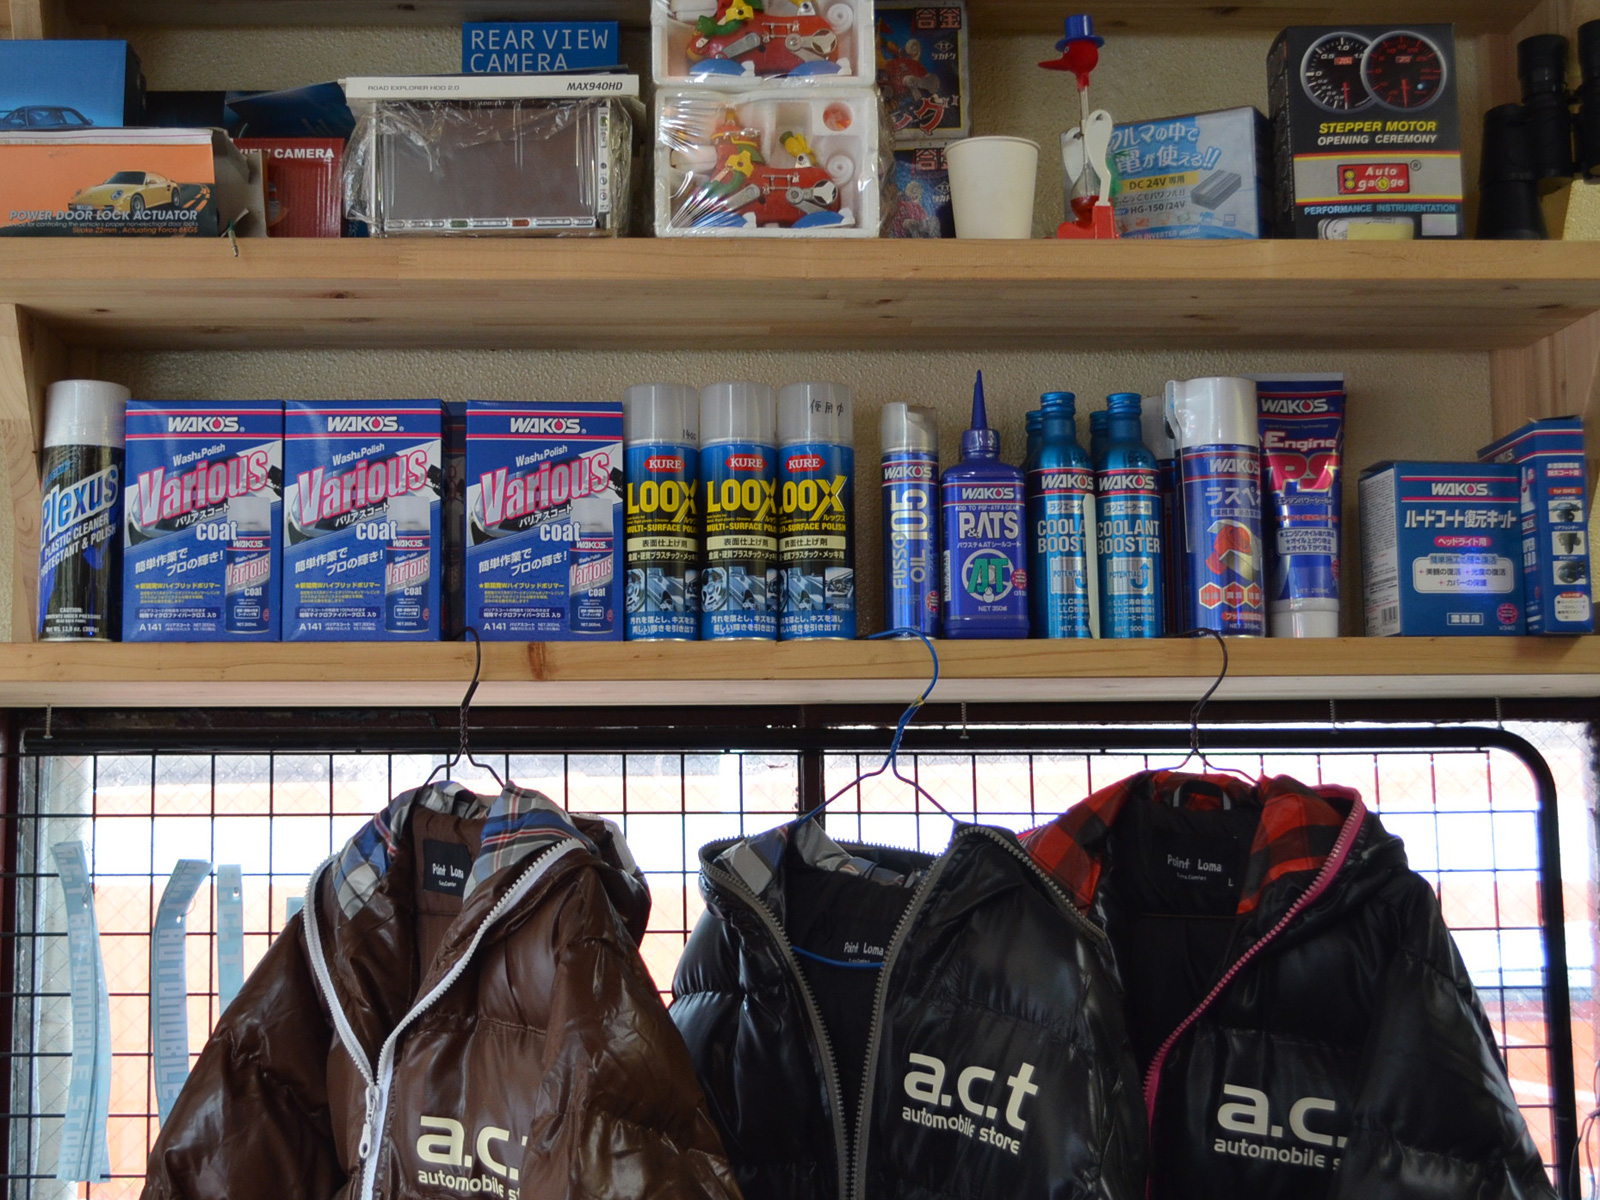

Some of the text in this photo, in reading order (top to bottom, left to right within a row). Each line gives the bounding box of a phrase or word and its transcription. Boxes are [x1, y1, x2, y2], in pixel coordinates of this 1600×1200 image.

[472, 29, 609, 49] REAR VIEW
[470, 53, 568, 72] CAMERA
[566, 81, 623, 92] MAX940HD
[1108, 123, 1199, 150] クルマの中で
[1319, 121, 1437, 134] STEPPER MOTOR
[1317, 134, 1437, 145] OPENING CEREMONY
[274, 148, 334, 159] CAMERA
[915, 149, 948, 171] 合
[1365, 166, 1398, 176] Auto
[1129, 180, 1144, 190] DC
[1146, 178, 1167, 189] 24V
[9, 209, 198, 221] POWER DOOR LOCK ACTUATOR
[1130, 201, 1185, 215] HG-150/24V
[1304, 204, 1456, 215] PERFORMANCE INSTRUMENTATION
[122, 227, 157, 236] Actuating
[1264, 431, 1337, 451] Engine
[648, 459, 682, 470] KURE
[730, 457, 763, 468] KURE
[788, 458, 820, 469] KURE
[138, 450, 269, 527] Various
[297, 450, 428, 527] Various
[480, 452, 610, 527] Various
[780, 474, 846, 522] OOX
[41, 464, 119, 553] Plexus
[627, 478, 698, 523] LOOX
[707, 477, 777, 522] LOOX
[1050, 502, 1084, 511] ラジエータ
[175, 504, 230, 528] バリアスコート
[335, 504, 390, 528] バリアスコート
[519, 505, 573, 529] バリアスコート
[891, 489, 928, 541] 105
[1404, 510, 1517, 528] ハードコート復元キット
[45, 512, 109, 561] PLASTIC CLEANER
[81, 537, 89, 550] &
[91, 523, 117, 546] POLISH
[196, 521, 238, 541] coat
[356, 521, 398, 541] coat
[539, 522, 581, 542] coat
[627, 524, 680, 534] MULTI-SURFACE
[707, 522, 762, 532] MULTI-SURFACE
[822, 523, 846, 531] POLISH
[1037, 518, 1086, 536] COOLA
[1098, 520, 1160, 537] COOLANT
[1038, 536, 1087, 553] BOOST
[1098, 537, 1160, 554] BOOSTER
[1437, 537, 1487, 547] ヘッドライト用
[135, 547, 188, 574] 簡単作業で
[295, 547, 348, 574] 簡単作業で
[479, 548, 532, 575] 簡単作業で
[910, 549, 927, 583] OIL
[226, 557, 269, 587] Various
[386, 557, 429, 587] Various
[570, 558, 613, 588] Various
[967, 558, 1009, 593] AT
[244, 587, 262, 596] coat
[404, 587, 422, 596] coat
[588, 588, 606, 597] coat
[1167, 854, 1222, 872] Point Loma
[863, 942, 884, 956] Loma
[69, 914, 93, 1080] AUTOMOBILE
[903, 1052, 1039, 1132] a.c.t
[60, 1095, 88, 1180] STORE
[902, 1106, 1021, 1155] automobile store
[1214, 1136, 1327, 1168] automobile
[417, 1170, 505, 1200] automobile
